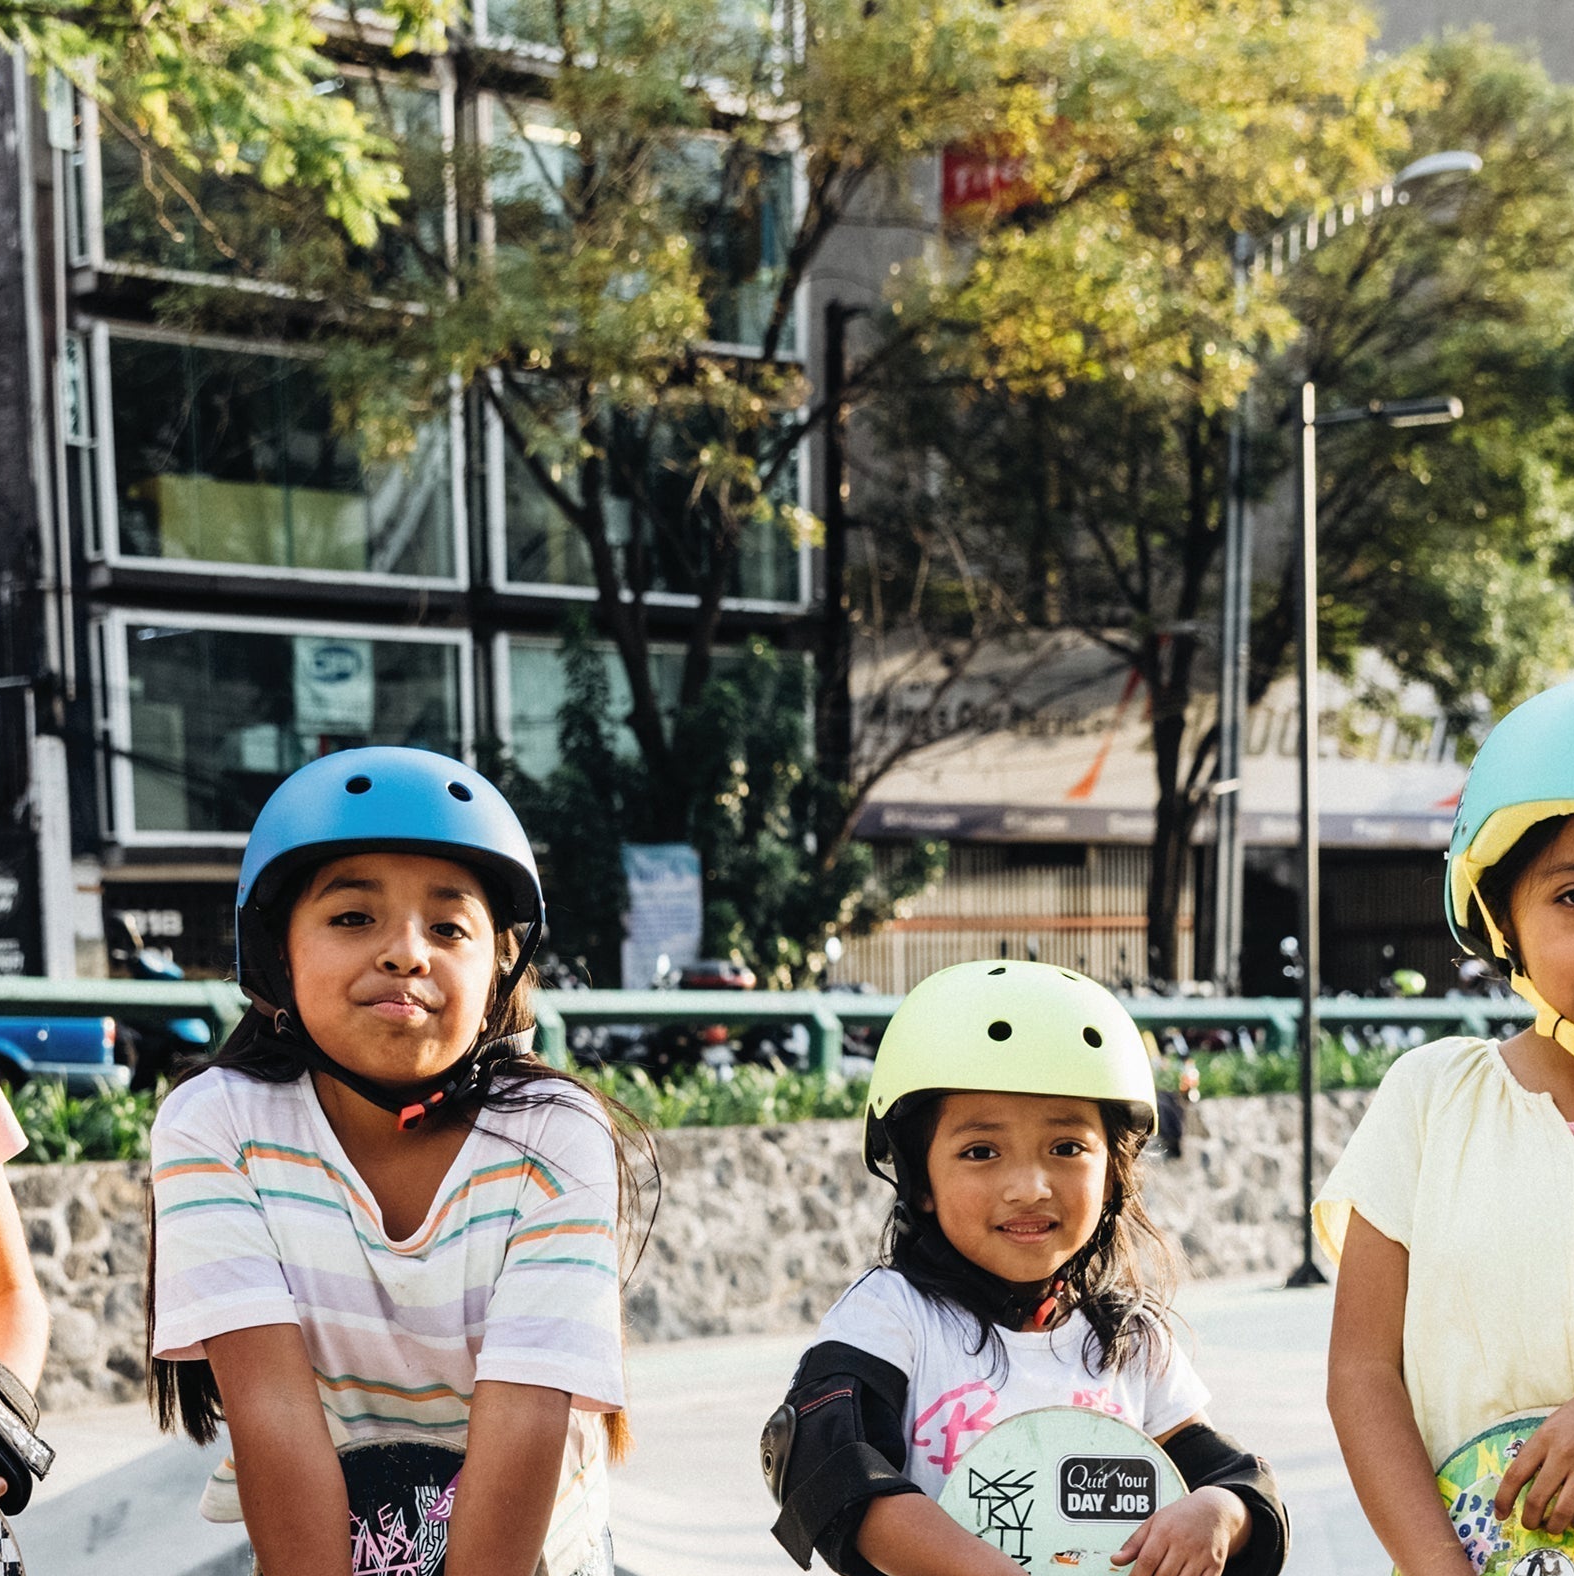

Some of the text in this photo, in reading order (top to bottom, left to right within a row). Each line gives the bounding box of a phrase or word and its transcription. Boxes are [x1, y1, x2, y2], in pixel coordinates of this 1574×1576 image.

[1066, 1464, 1150, 1491] Quit Your
[1067, 1493, 1151, 1514] DAY JOB
